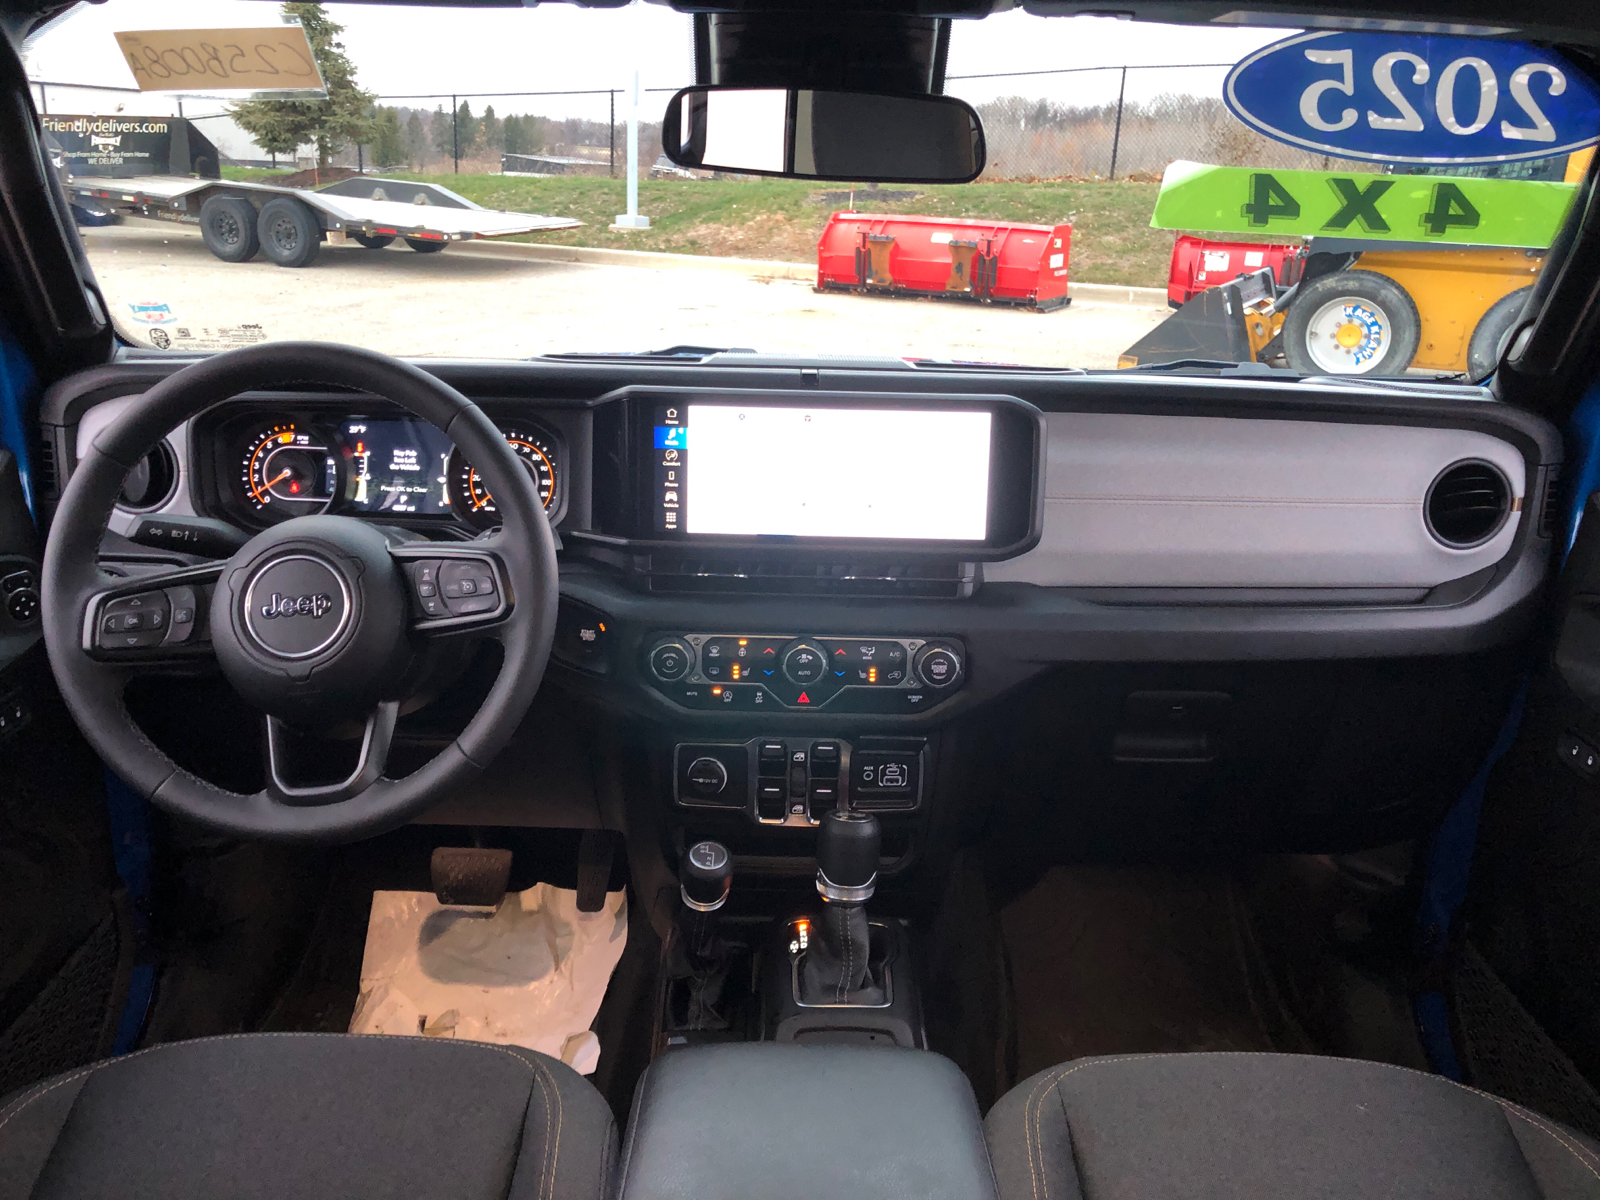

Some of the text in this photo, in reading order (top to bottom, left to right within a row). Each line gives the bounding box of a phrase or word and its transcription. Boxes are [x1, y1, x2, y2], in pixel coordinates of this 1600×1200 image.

[42, 118, 168, 135] Friendlydelivers.com
[277, 436, 283, 444] 6
[266, 441, 273, 449] 5
[258, 450, 264, 458] 4
[532, 453, 542, 461] 80
[253, 462, 260, 470] 3
[253, 474, 260, 482] 2
[261, 592, 333, 620] Jeep
[127, 617, 139, 625] OK
